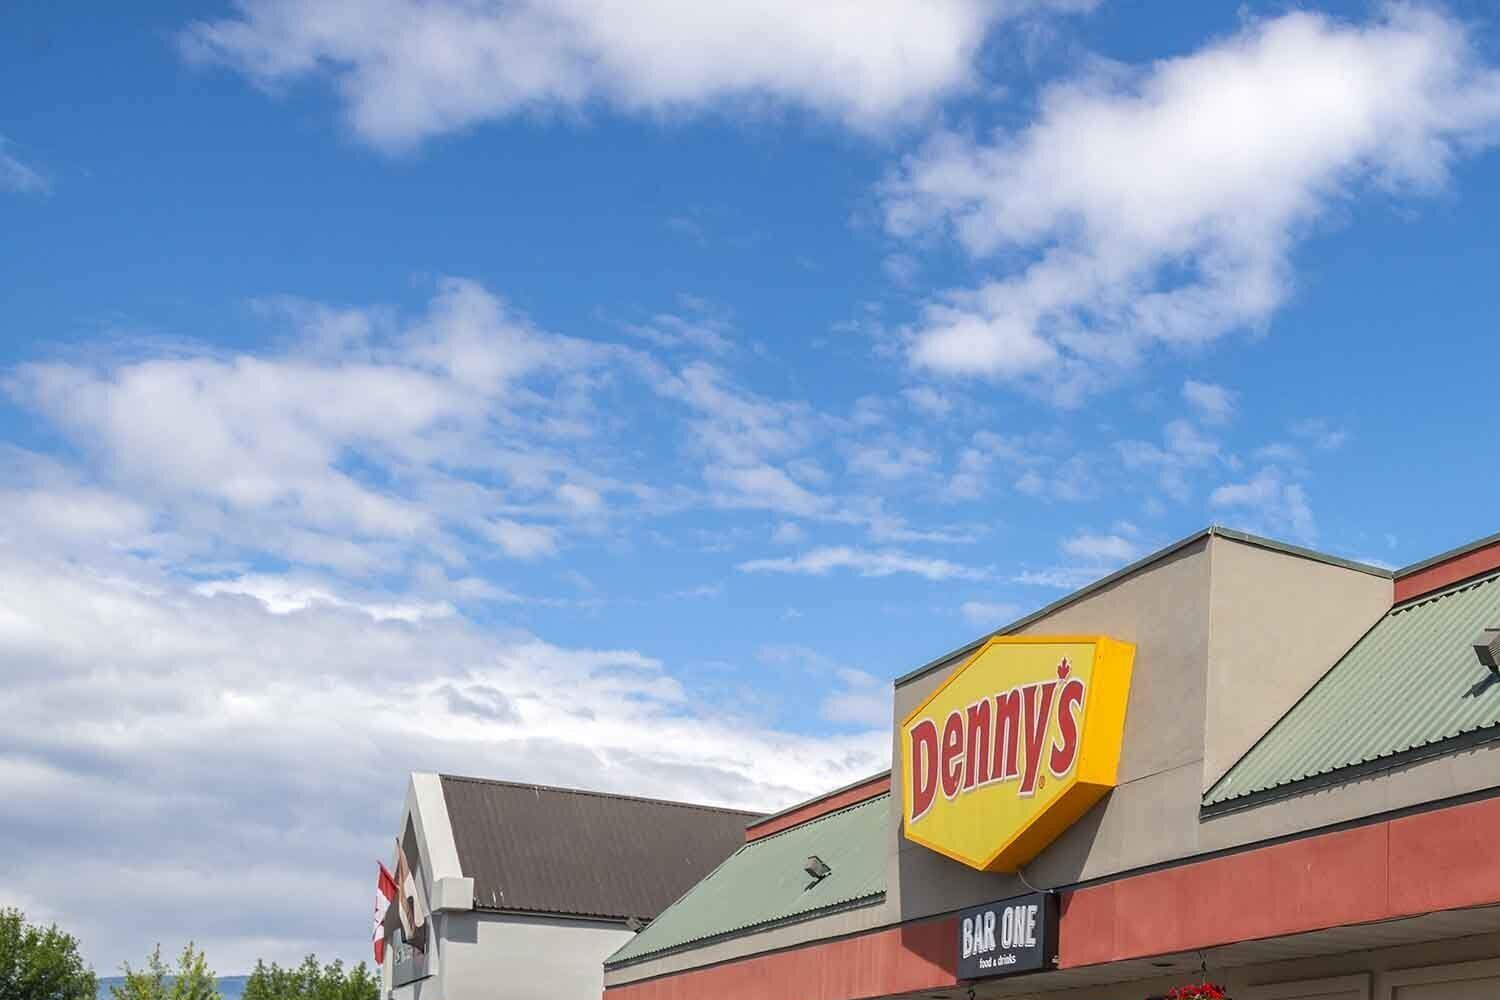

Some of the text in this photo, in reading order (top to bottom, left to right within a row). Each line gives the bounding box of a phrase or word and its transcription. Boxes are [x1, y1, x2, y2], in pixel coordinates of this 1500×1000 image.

[910, 657, 1085, 822] Denny's
[963, 905, 1038, 959] BAR ONE
[980, 956, 992, 968] food
[998, 953, 1016, 966] drinks
